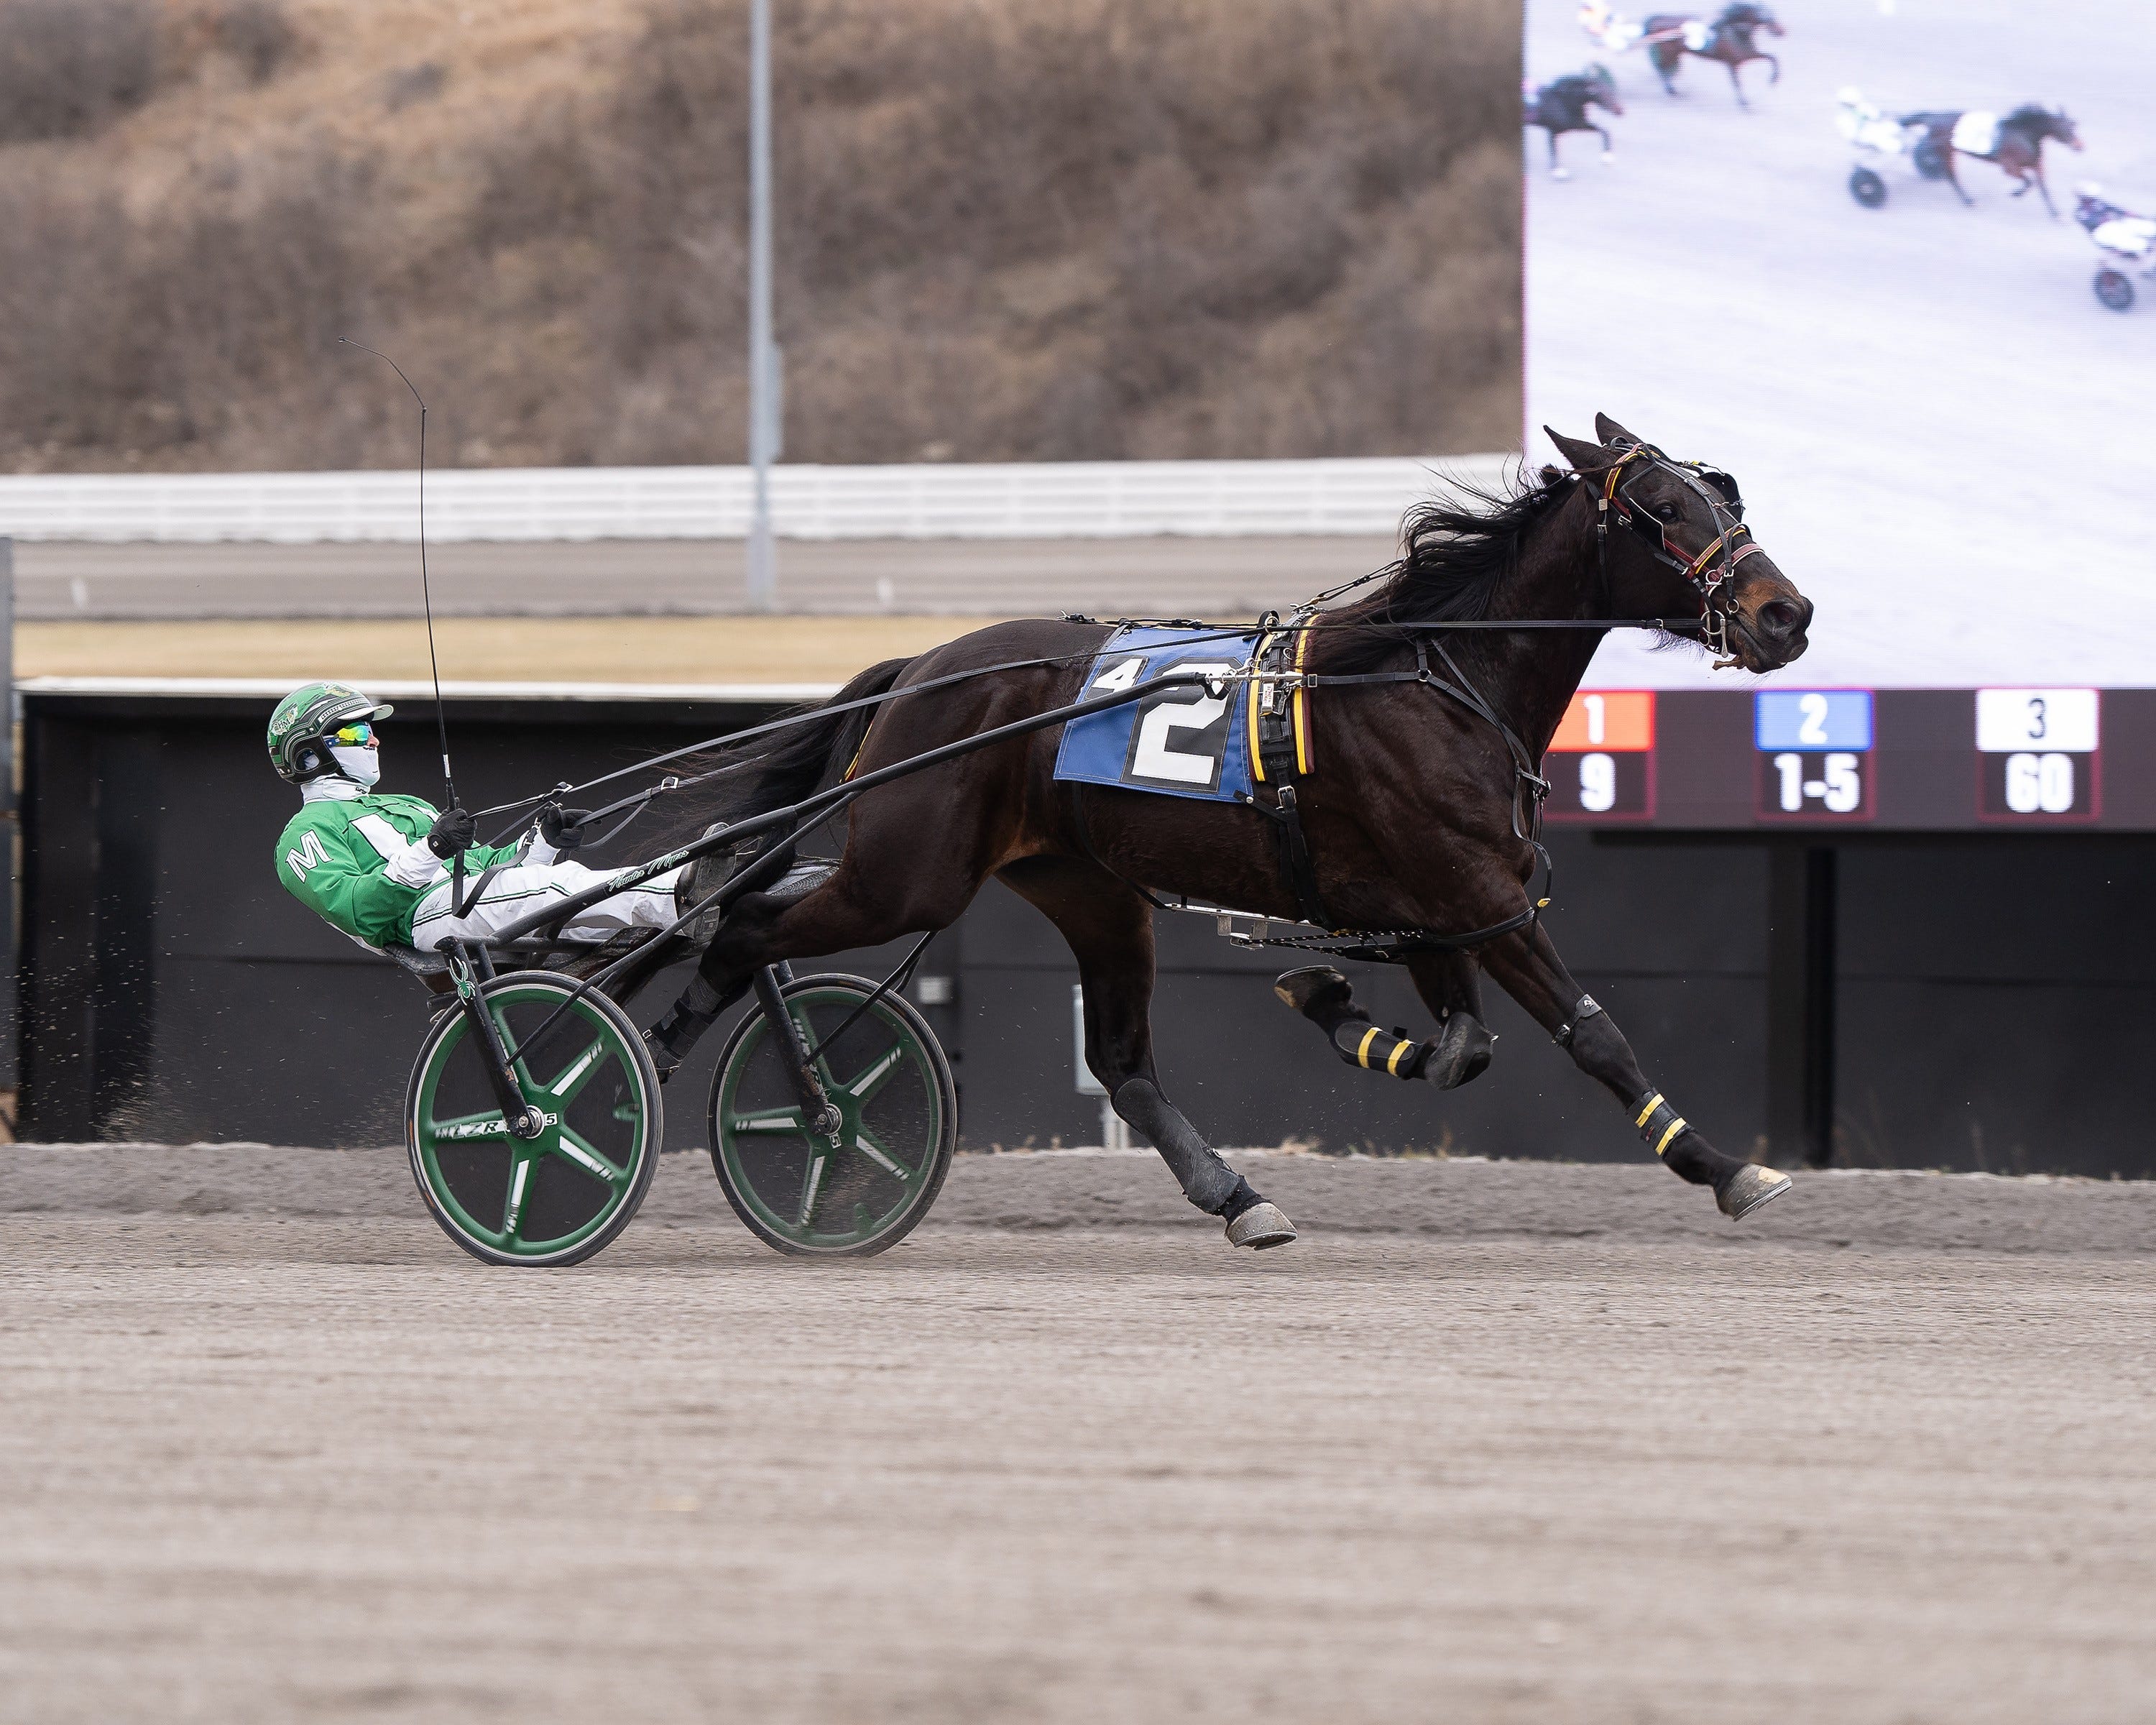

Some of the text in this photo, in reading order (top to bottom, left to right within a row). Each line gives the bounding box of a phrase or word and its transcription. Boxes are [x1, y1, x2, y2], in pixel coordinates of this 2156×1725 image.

[1131, 663, 1235, 785] 2
[1583, 695, 1605, 745] 1
[1798, 694, 1828, 745] 2
[2027, 696, 2047, 740] 3
[1579, 753, 1616, 813] 9
[1774, 753, 1861, 813] 1-5
[2005, 753, 2075, 814] 60
[285, 829, 334, 883] M
[607, 850, 690, 892] Hunter Myers
